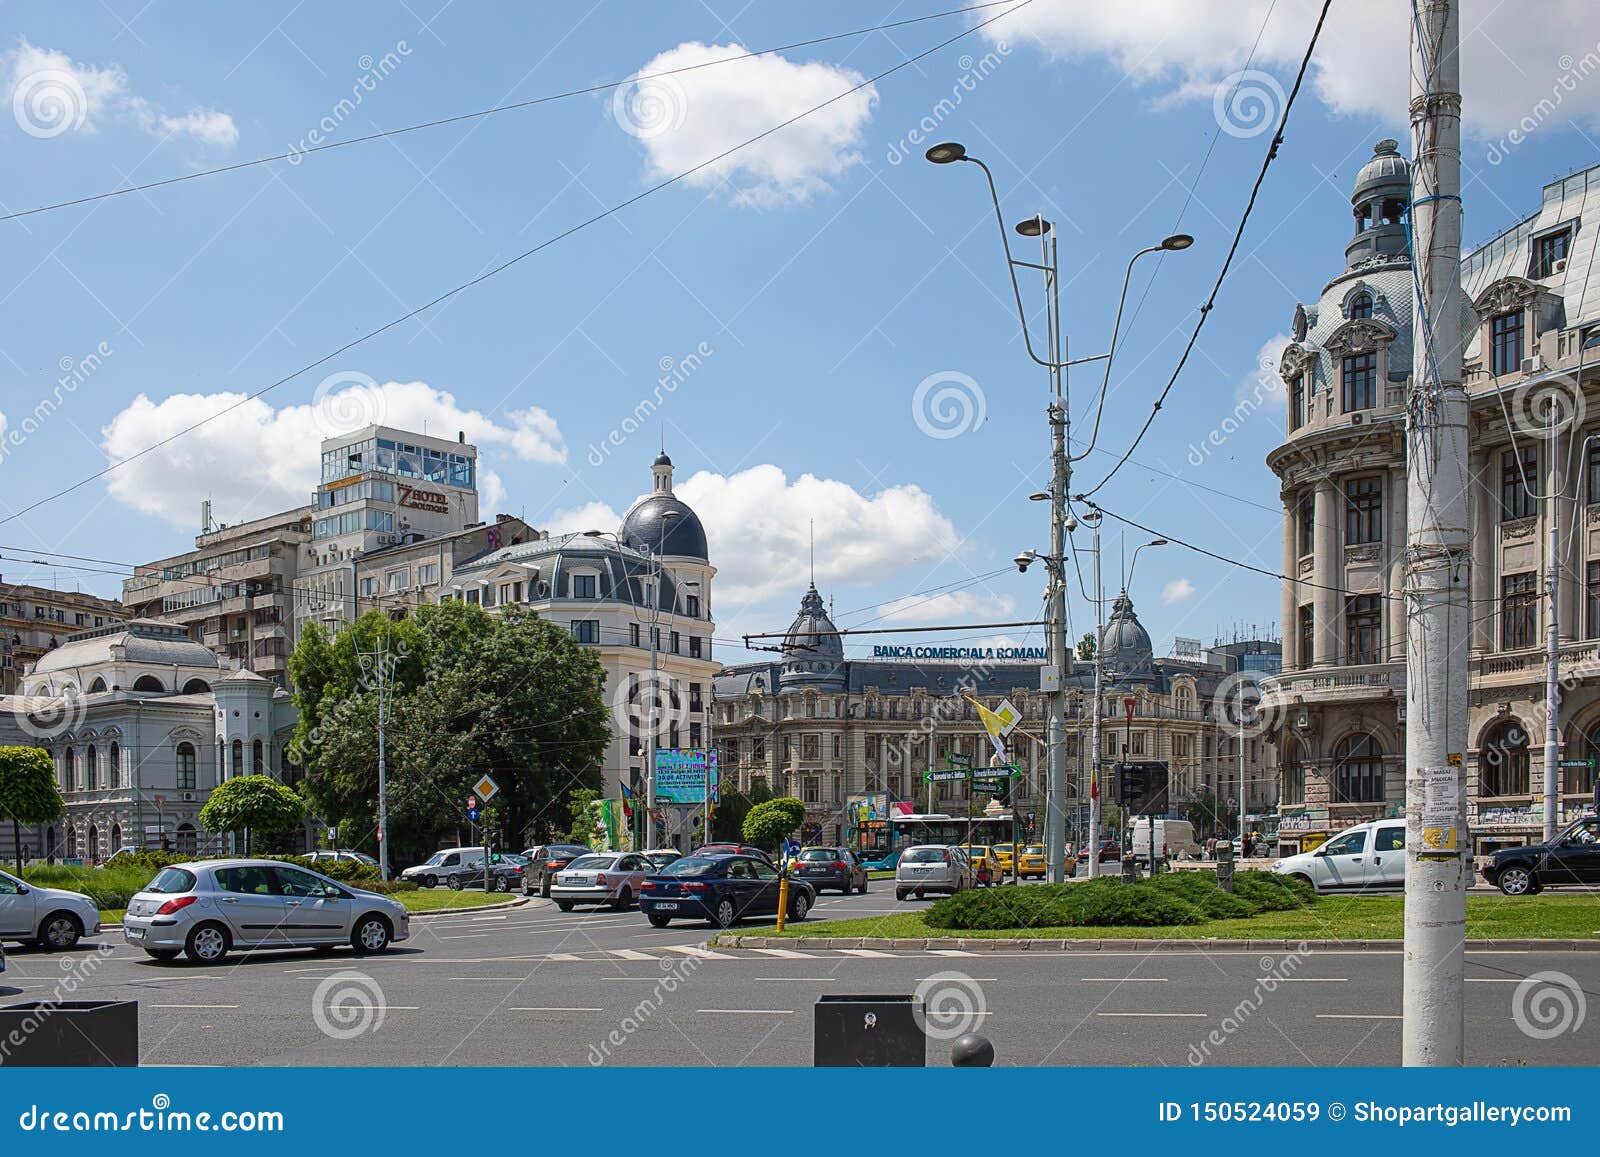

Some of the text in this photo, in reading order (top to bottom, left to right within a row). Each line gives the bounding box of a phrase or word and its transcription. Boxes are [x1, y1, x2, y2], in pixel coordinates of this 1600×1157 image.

[412, 489, 449, 504] HOTEL
[411, 502, 449, 514] BOUTIQUE
[873, 645, 914, 658] BANCA
[915, 646, 994, 659] COMERCIALA
